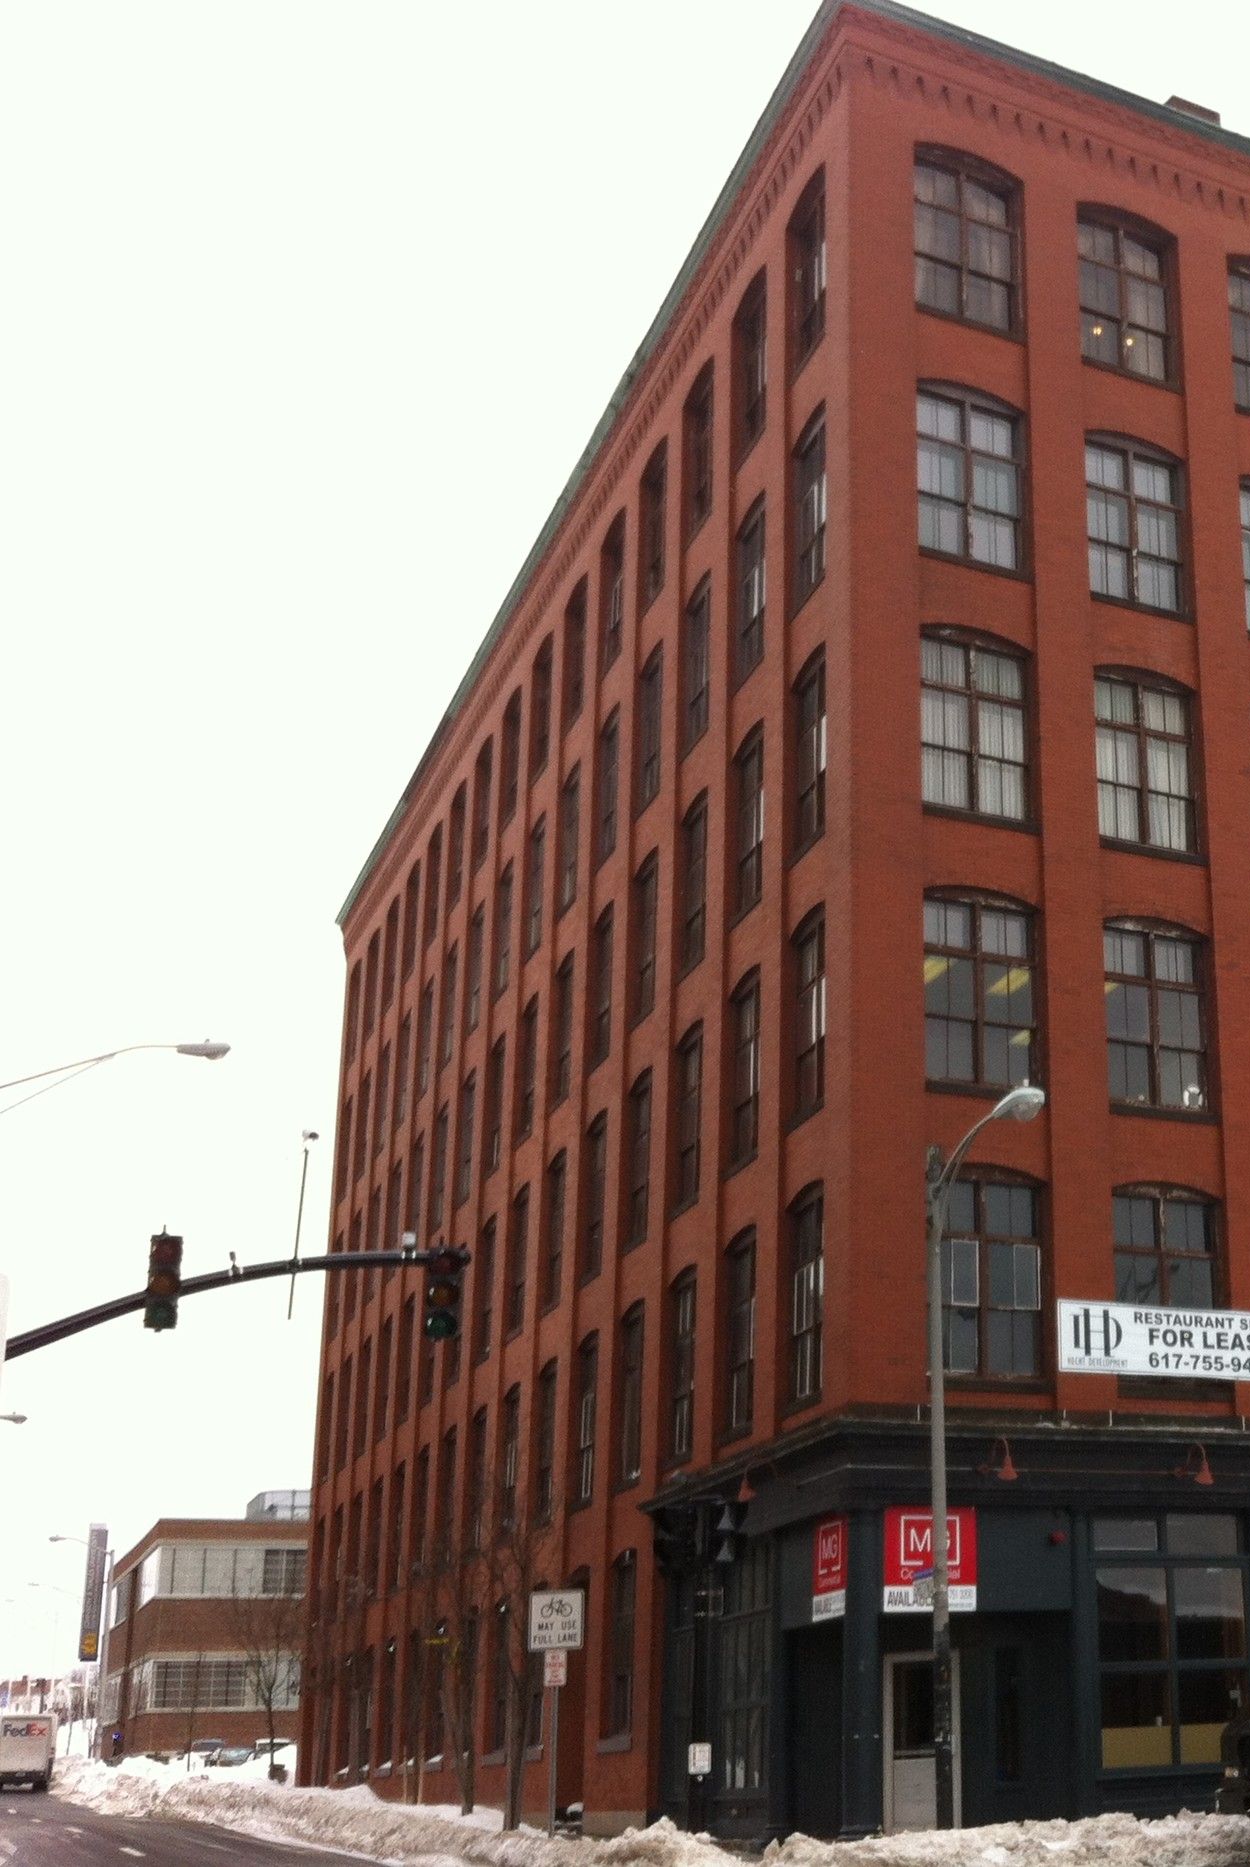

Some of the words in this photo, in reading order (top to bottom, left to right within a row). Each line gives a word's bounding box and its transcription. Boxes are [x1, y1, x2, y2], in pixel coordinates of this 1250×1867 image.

[1134, 1311, 1234, 1329] RESTAURANT
[1148, 1327, 1194, 1349] FOR
[822, 1533, 838, 1560] MG
[910, 1527, 951, 1553] M
[538, 1622, 554, 1631] MAY
[561, 1620, 577, 1630] USE
[533, 1635, 553, 1645] FULL
[557, 1634, 577, 1643] LANE
[3, 1722, 47, 1737] FedEx
